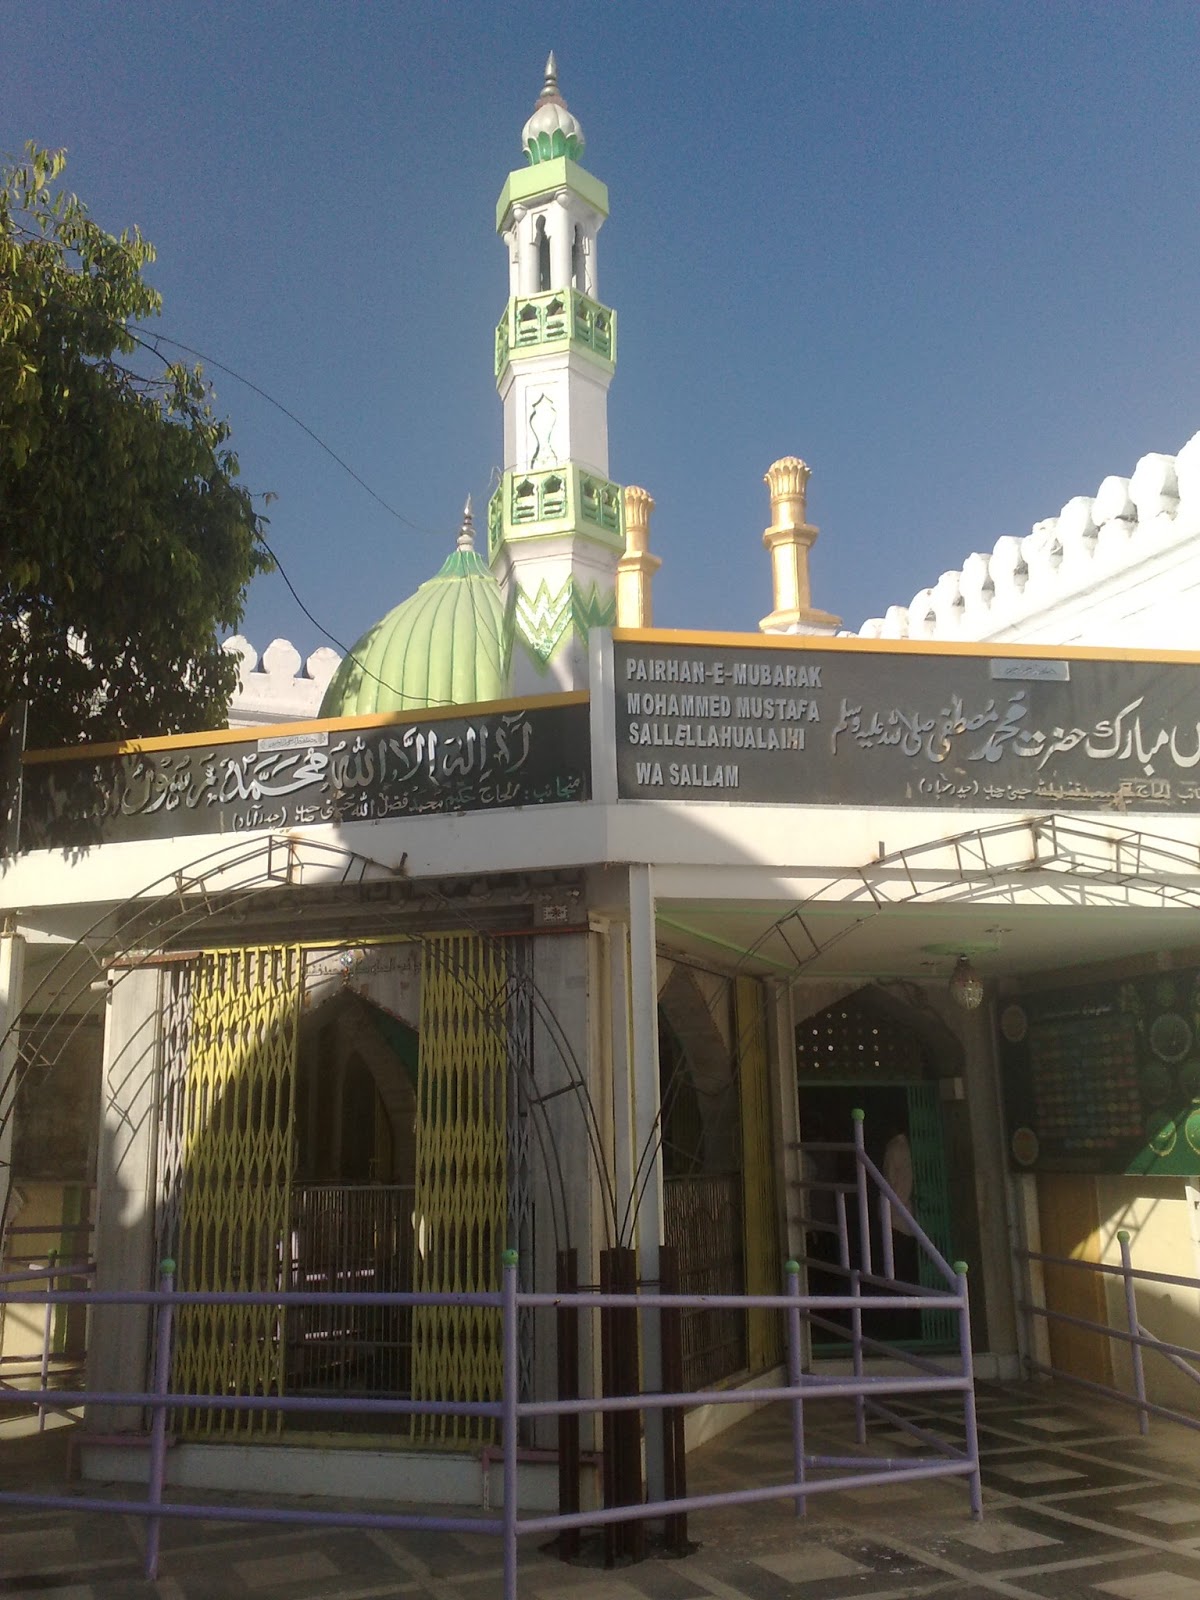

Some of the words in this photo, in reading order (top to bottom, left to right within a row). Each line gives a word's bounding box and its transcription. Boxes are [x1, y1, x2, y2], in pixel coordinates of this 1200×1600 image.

[626, 658, 823, 688] PAIRHAN-E-MUBARAK
[627, 692, 731, 718] MOHAMMED
[737, 696, 820, 722] MUSTAFA
[628, 722, 806, 751] SALLELLAHUALAIHI
[635, 762, 664, 786] WA
[668, 763, 740, 788] SALLAM
